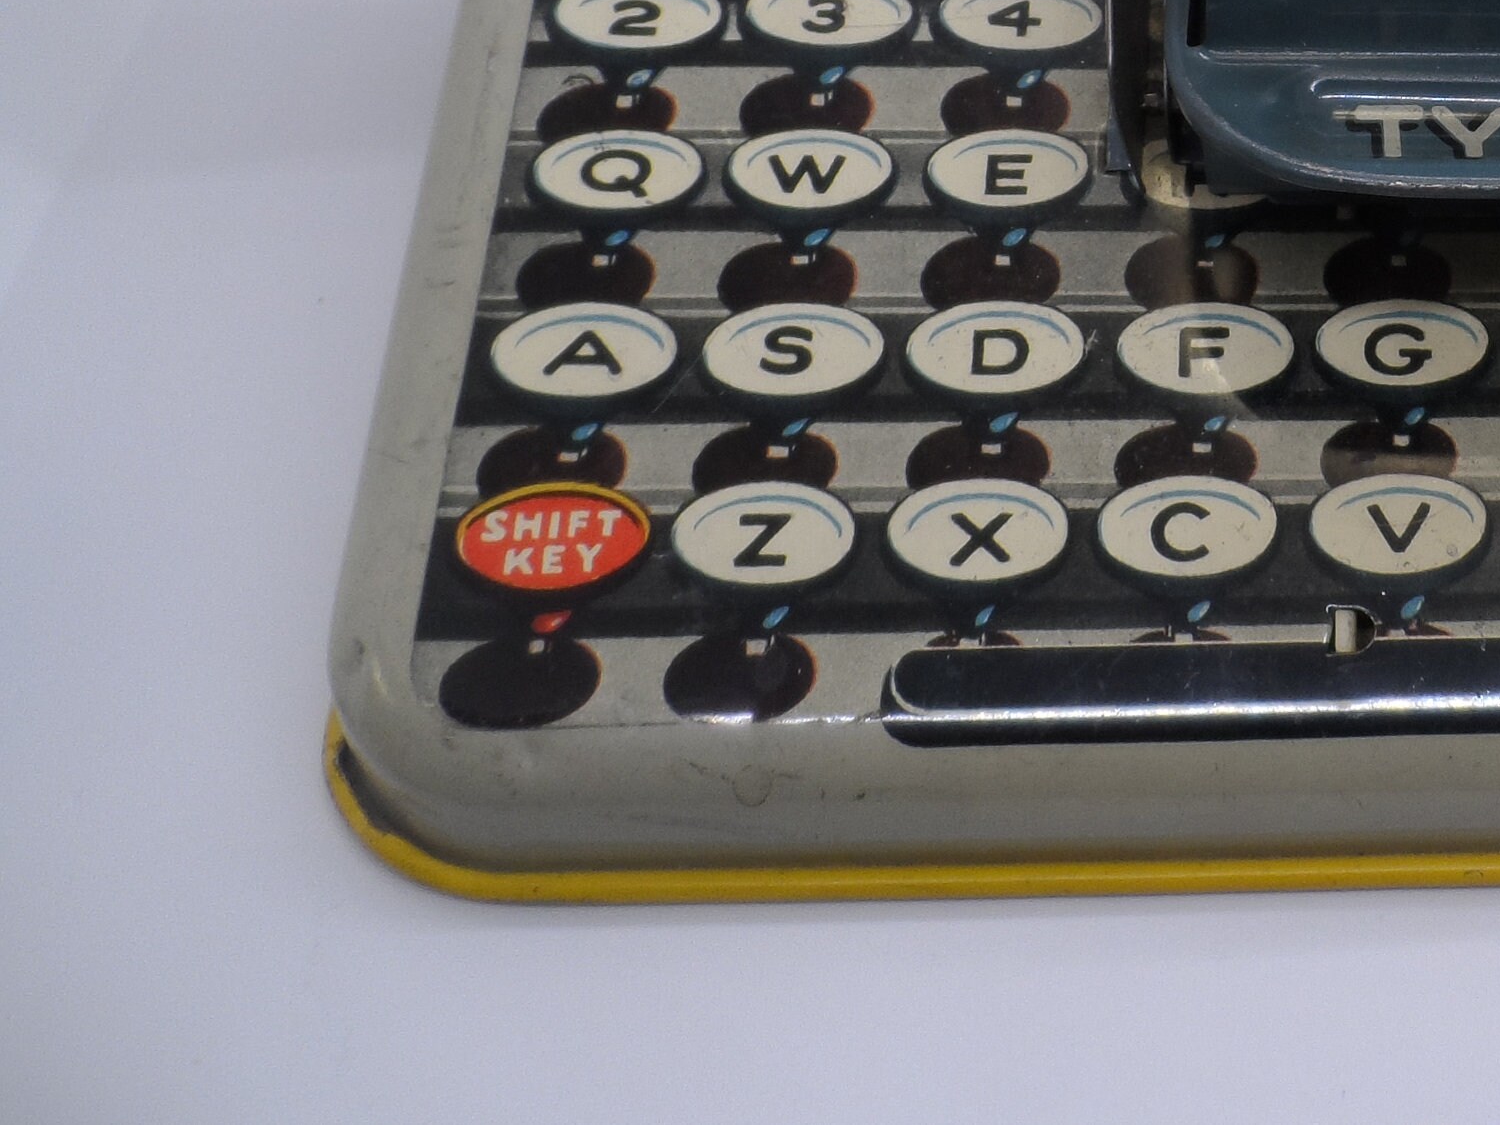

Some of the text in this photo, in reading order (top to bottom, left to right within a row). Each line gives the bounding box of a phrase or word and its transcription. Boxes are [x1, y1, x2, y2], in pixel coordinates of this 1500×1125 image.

[986, 0, 1043, 39] 4
[579, 148, 653, 199] Q
[767, 153, 847, 196] W
[983, 152, 1034, 197] E
[541, 329, 624, 377] A
[758, 324, 815, 377] S
[969, 327, 1031, 377] D
[1177, 324, 1232, 380] F
[1362, 321, 1434, 378] G
[479, 508, 622, 543] SHIFT
[732, 512, 793, 569] Z
[948, 511, 1014, 568] X
[1149, 500, 1212, 564] C
[1365, 500, 1432, 554] V
[502, 542, 603, 576] KEY
